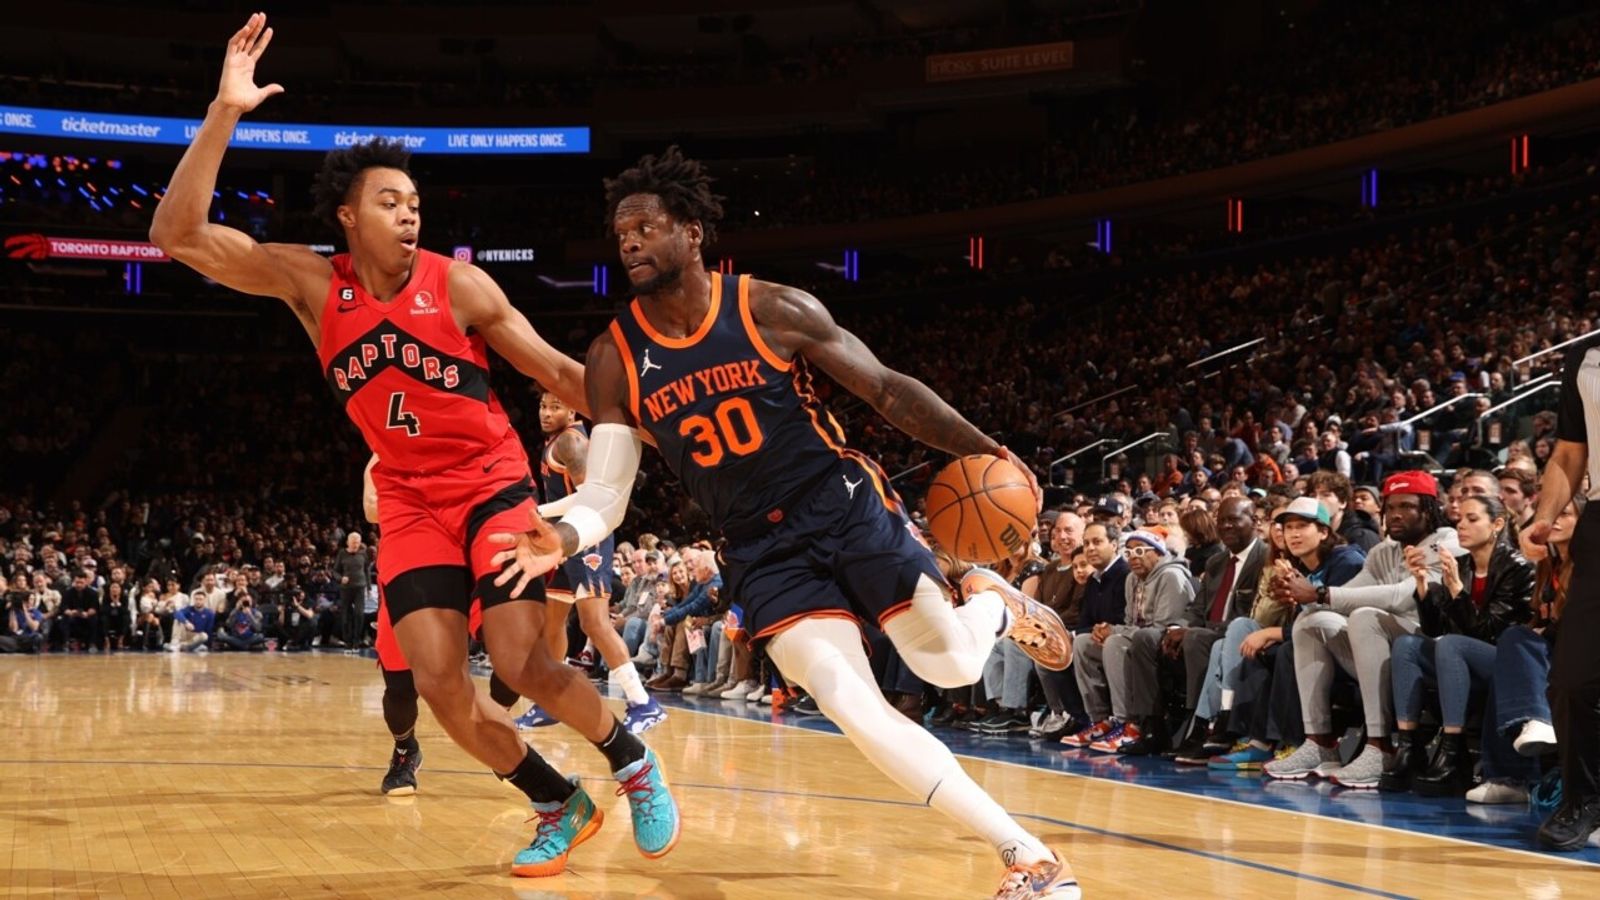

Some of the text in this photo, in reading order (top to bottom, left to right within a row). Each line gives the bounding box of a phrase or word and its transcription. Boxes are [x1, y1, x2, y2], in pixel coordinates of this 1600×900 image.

[980, 55, 1020, 71] SUITE
[1025, 50, 1068, 66] LEVEL
[4, 112, 37, 128] ONCE.
[61, 116, 161, 138] ticketmaster
[235, 128, 281, 143] HAPPENS
[282, 130, 311, 144] ONCE.
[448, 133, 567, 147] LIVE ONLY HAPPENS ONCE.
[51, 242, 164, 257] TORONTO RAPTORS
[477, 249, 534, 261] @NYKNICKS
[342, 289, 353, 300] 6
[334, 334, 460, 391] RAPTORS
[644, 360, 767, 422] NEW YORK
[386, 392, 420, 437] 4
[679, 397, 763, 467] 30
